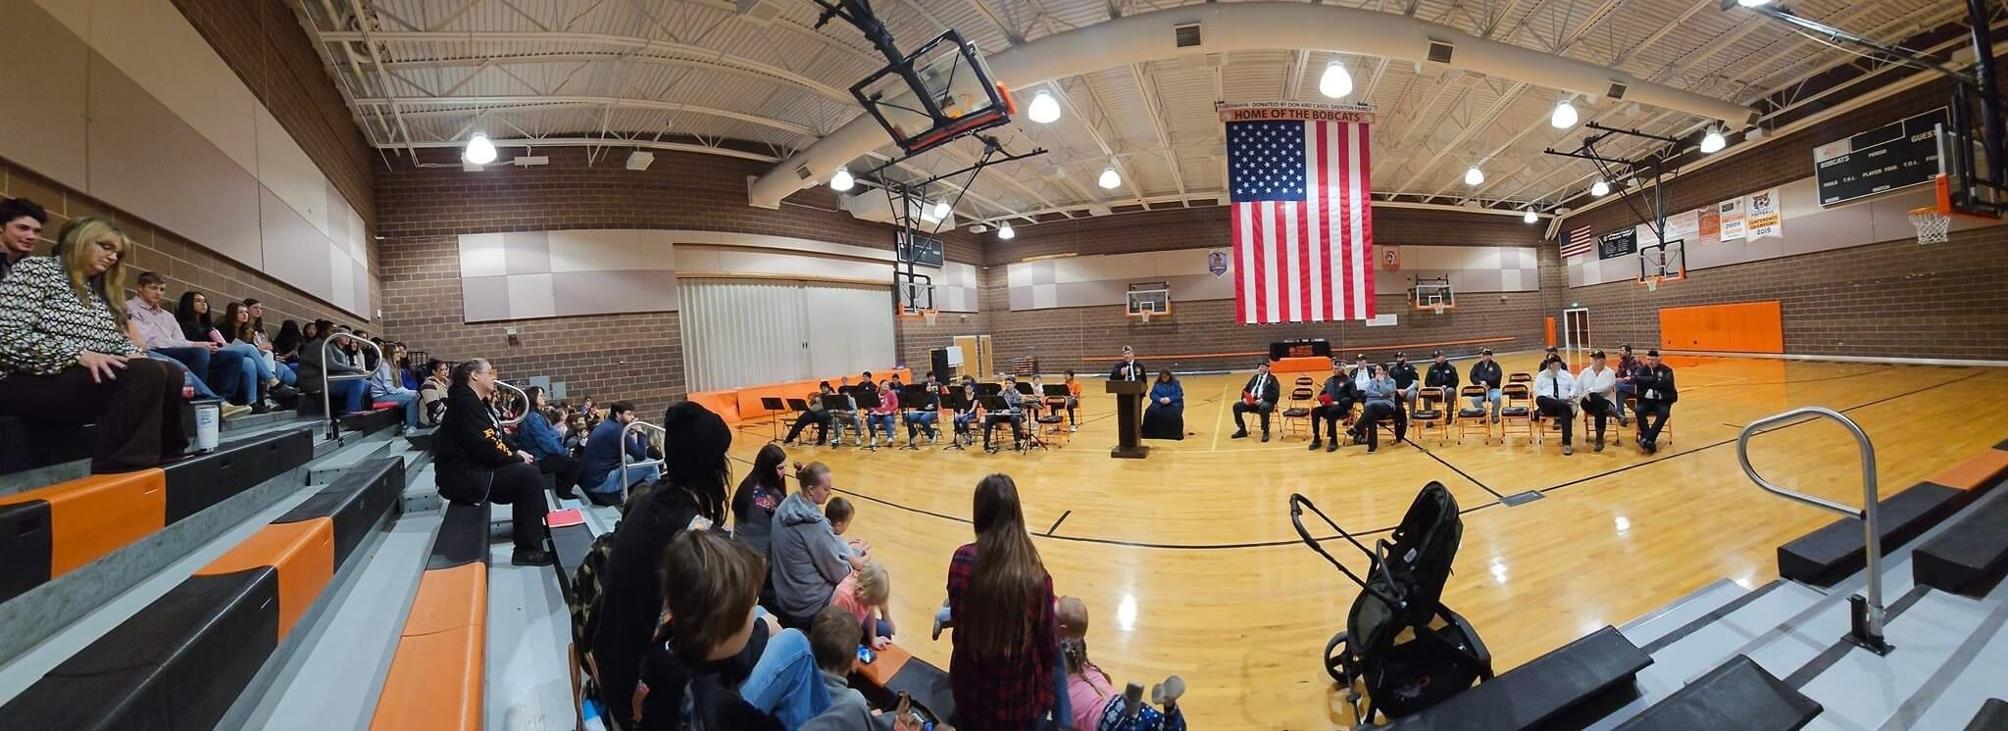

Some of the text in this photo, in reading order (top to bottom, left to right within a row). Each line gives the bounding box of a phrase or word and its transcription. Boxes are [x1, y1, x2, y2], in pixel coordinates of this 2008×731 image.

[1234, 109, 1360, 121] HOME OF THE BOBCATS
